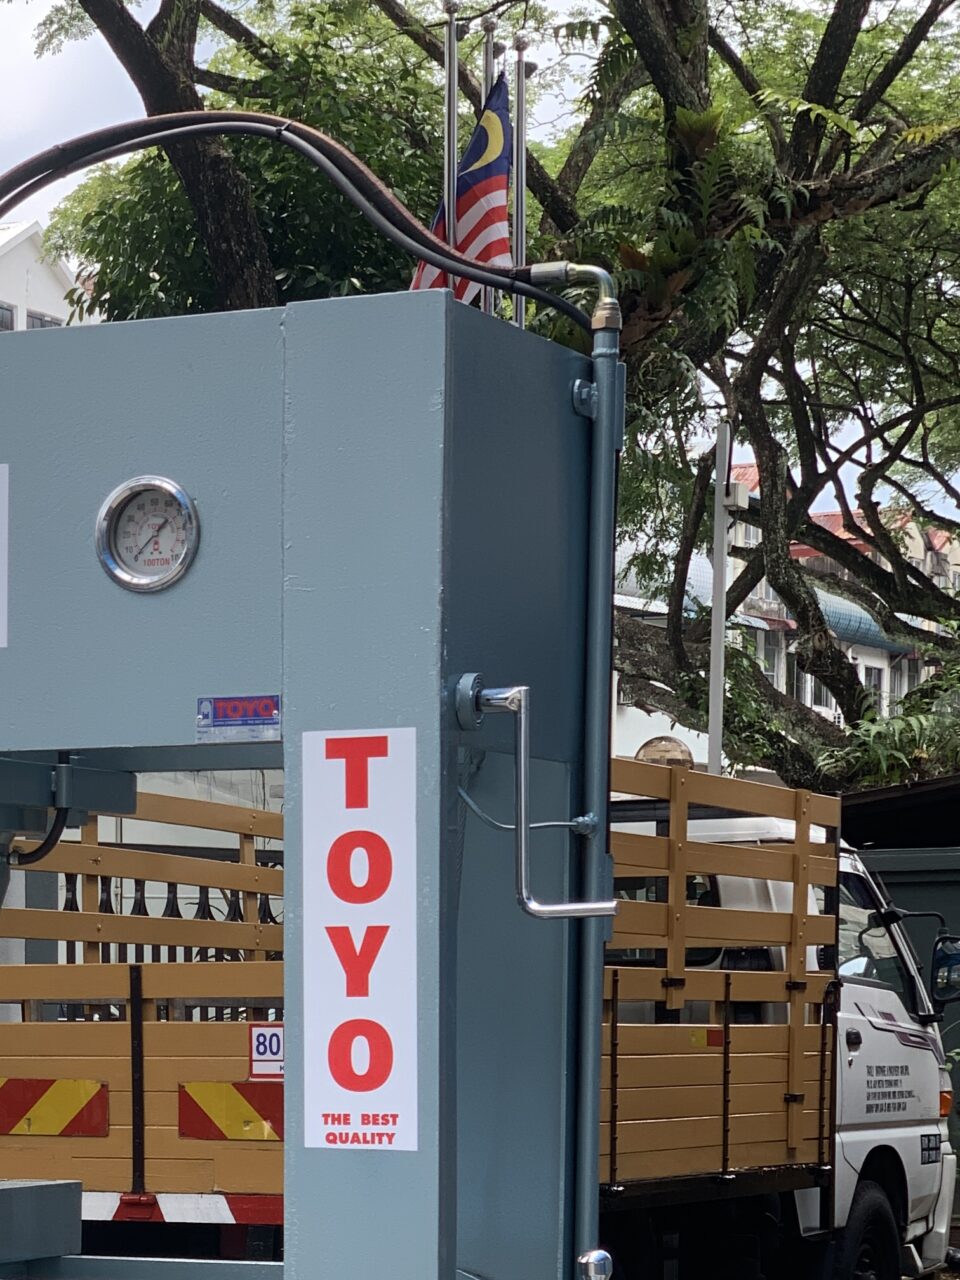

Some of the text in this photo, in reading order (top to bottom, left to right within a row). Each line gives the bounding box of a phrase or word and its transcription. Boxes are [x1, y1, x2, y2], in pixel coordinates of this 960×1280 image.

[215, 700, 275, 720] TOYO
[324, 735, 394, 1093] TOYO
[255, 1032, 281, 1056] 80
[322, 1113, 399, 1127] THE BEST
[325, 1131, 396, 1146] QUALITY
